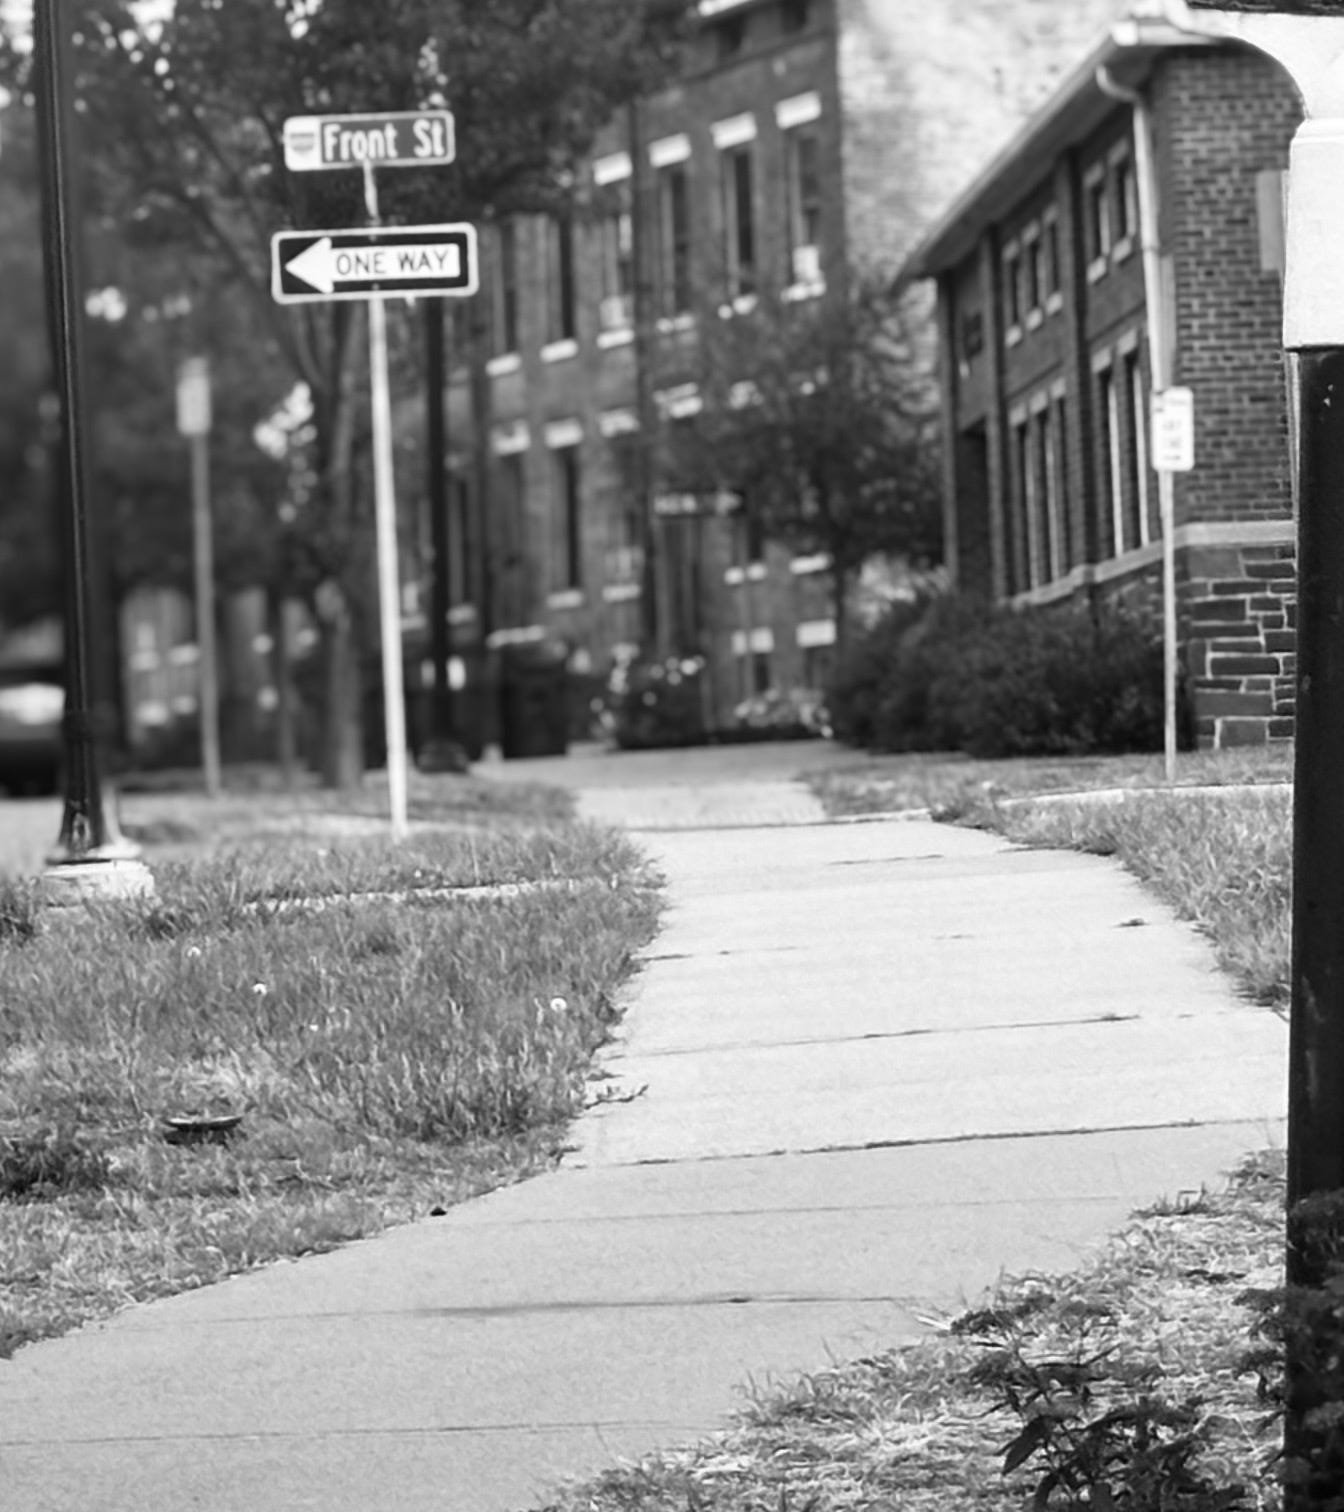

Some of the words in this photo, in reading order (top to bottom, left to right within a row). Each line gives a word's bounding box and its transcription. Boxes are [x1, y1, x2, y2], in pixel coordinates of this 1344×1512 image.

[323, 122, 398, 161] Front
[412, 118, 445, 158] St
[336, 251, 386, 275] ONE
[397, 249, 449, 272] WAY
